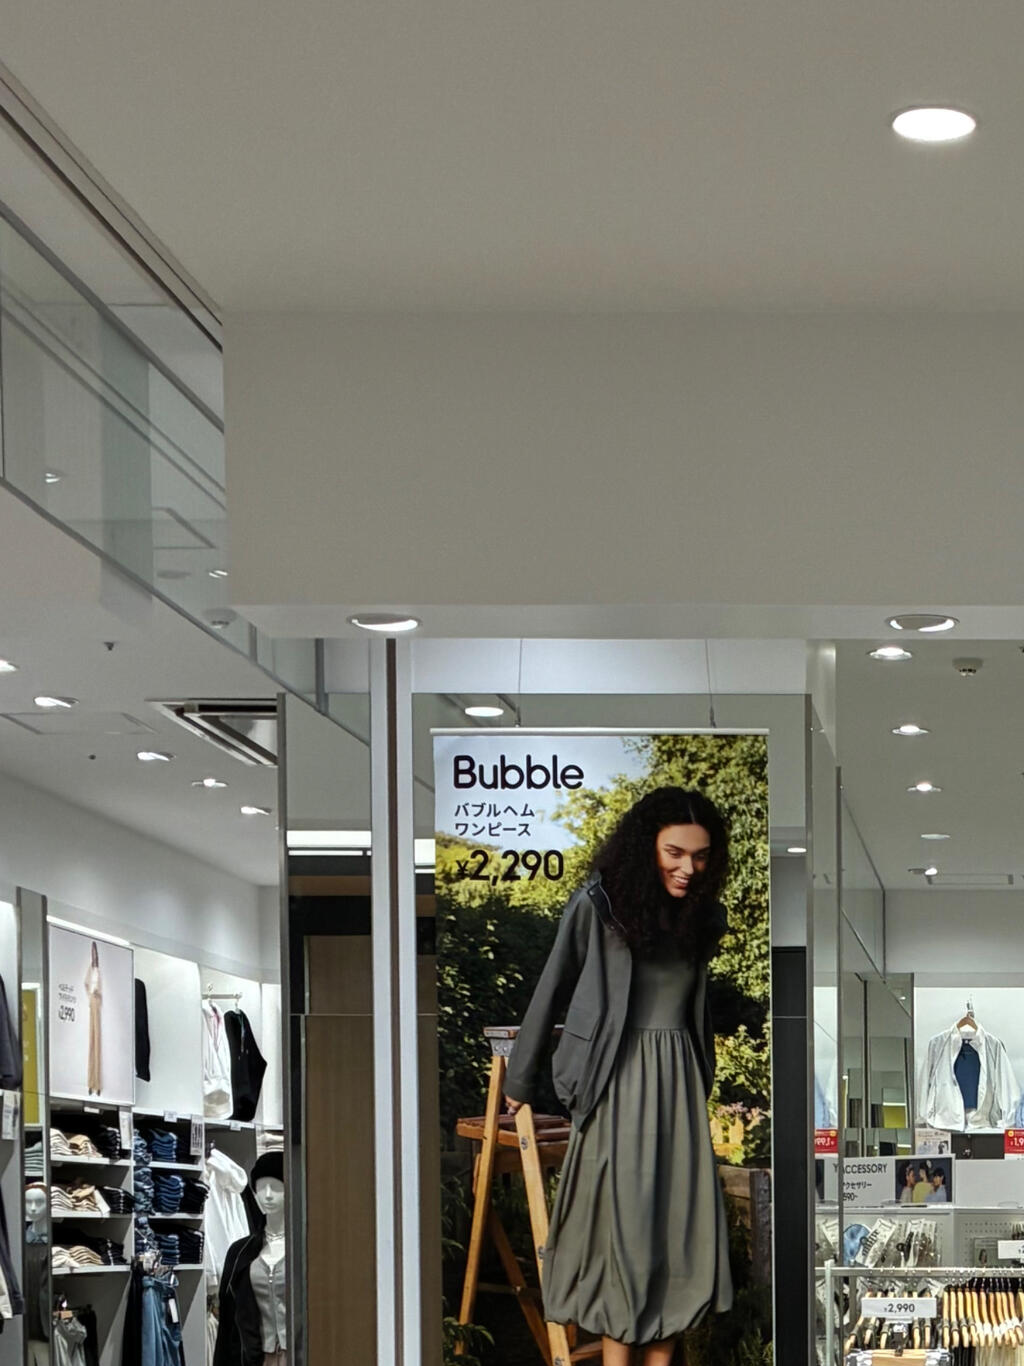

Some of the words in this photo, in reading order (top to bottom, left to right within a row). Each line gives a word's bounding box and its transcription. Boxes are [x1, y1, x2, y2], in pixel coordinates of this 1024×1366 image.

[452, 754, 585, 790] Bubble
[454, 802, 536, 818] バブルヘム
[454, 822, 532, 837] ワンピース
[455, 849, 565, 887] ¥2,290
[842, 1163, 888, 1175] CCESSORY
[884, 1303, 916, 1314] ¥2,990
